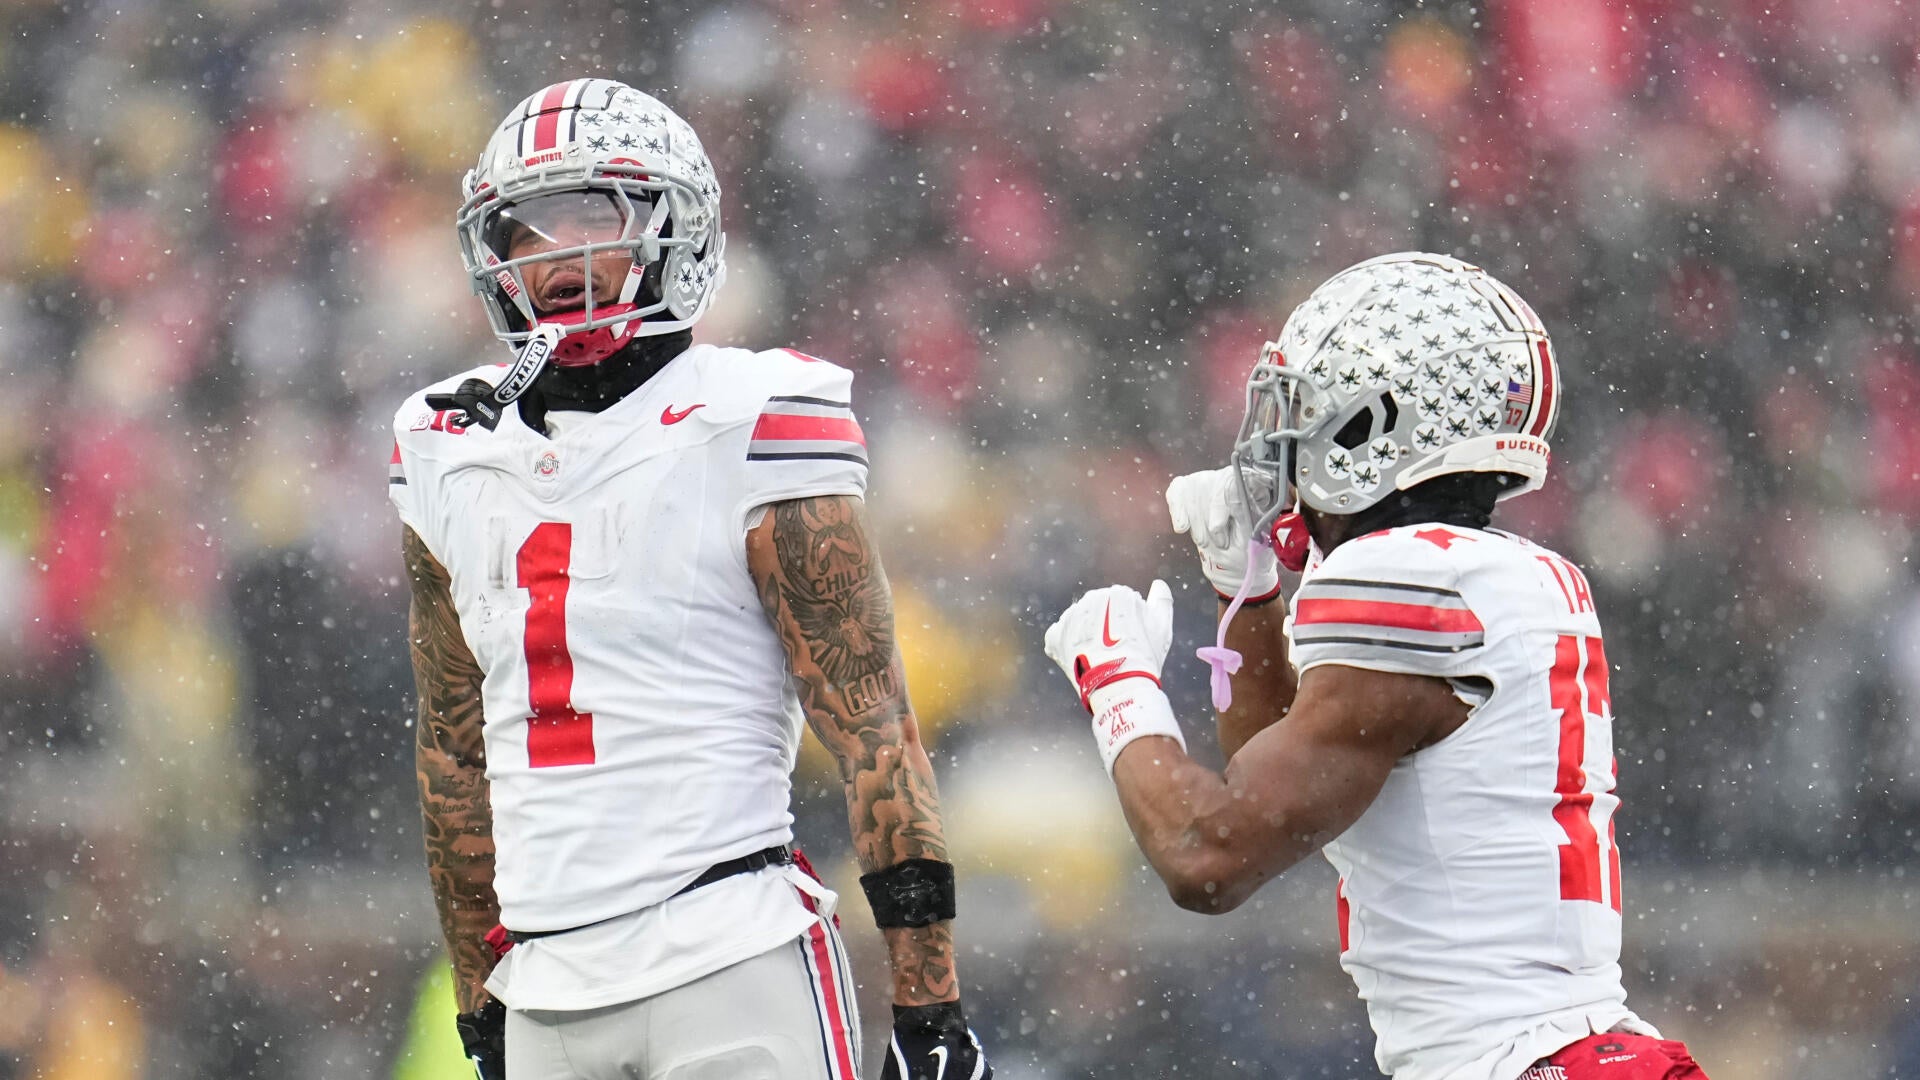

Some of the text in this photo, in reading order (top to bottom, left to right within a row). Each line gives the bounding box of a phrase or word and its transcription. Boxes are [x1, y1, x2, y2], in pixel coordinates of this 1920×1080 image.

[541, 151, 562, 163] STATE
[500, 342, 547, 399] BATTLE
[1506, 407, 1523, 427] 17
[1495, 440, 1550, 456] BUCKEY
[812, 566, 869, 596] CHILD
[516, 521, 595, 768] 1
[842, 665, 898, 717] GOD
